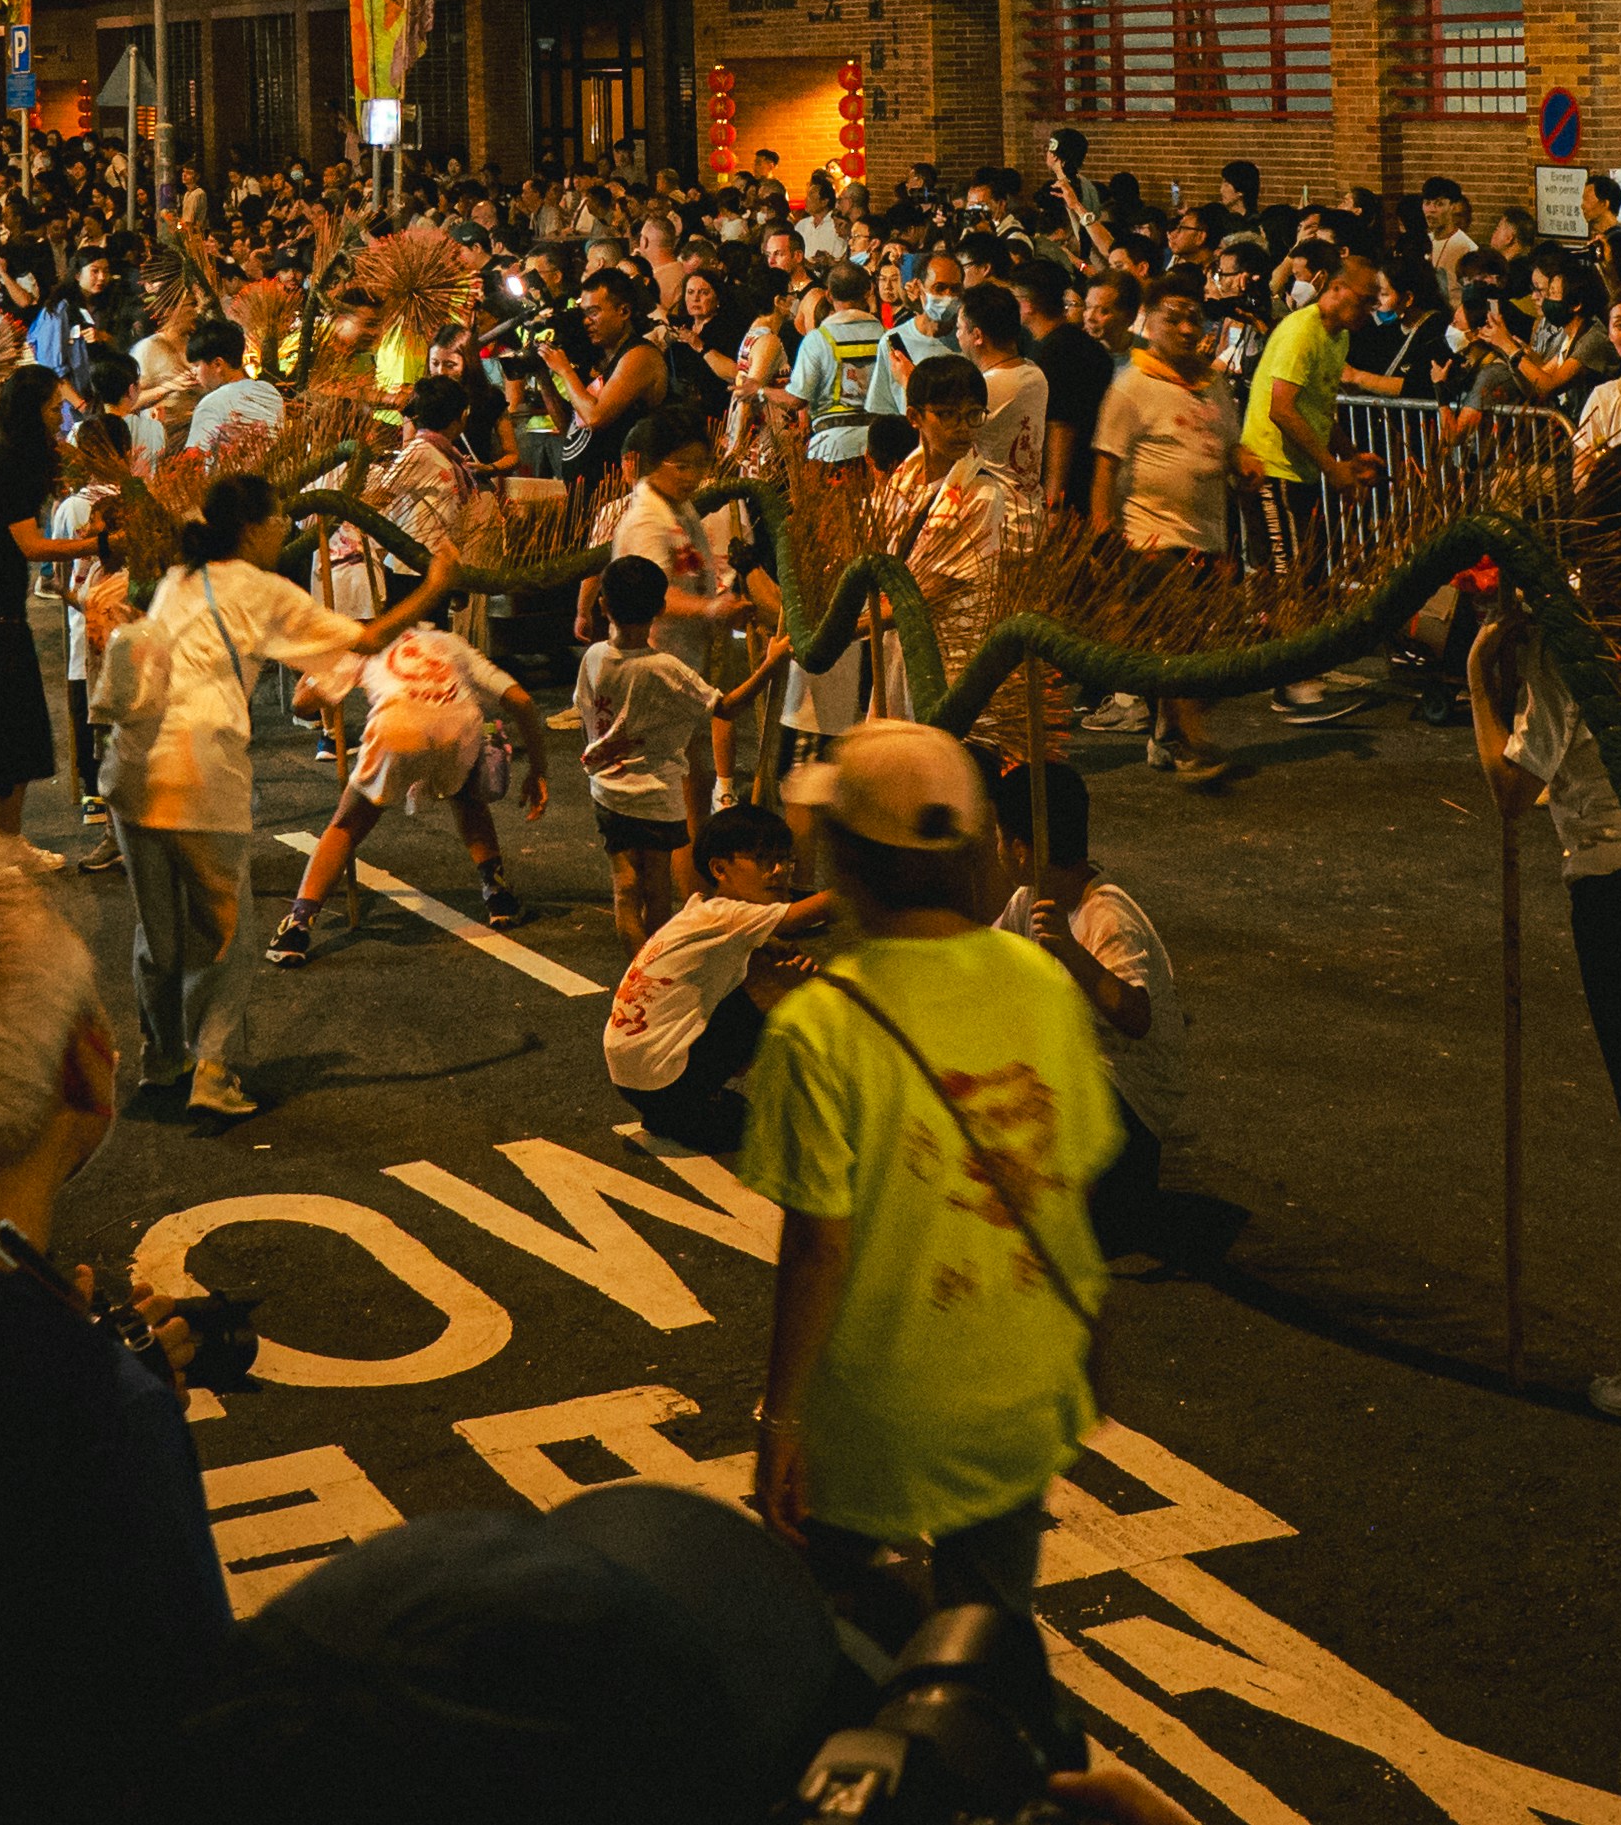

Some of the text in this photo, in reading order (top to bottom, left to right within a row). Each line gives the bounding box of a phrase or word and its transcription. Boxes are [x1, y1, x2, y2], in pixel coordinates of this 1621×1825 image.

[13, 30, 27, 69] P
[1550, 171, 1574, 183] Except
[129, 1122, 781, 1420] OW
